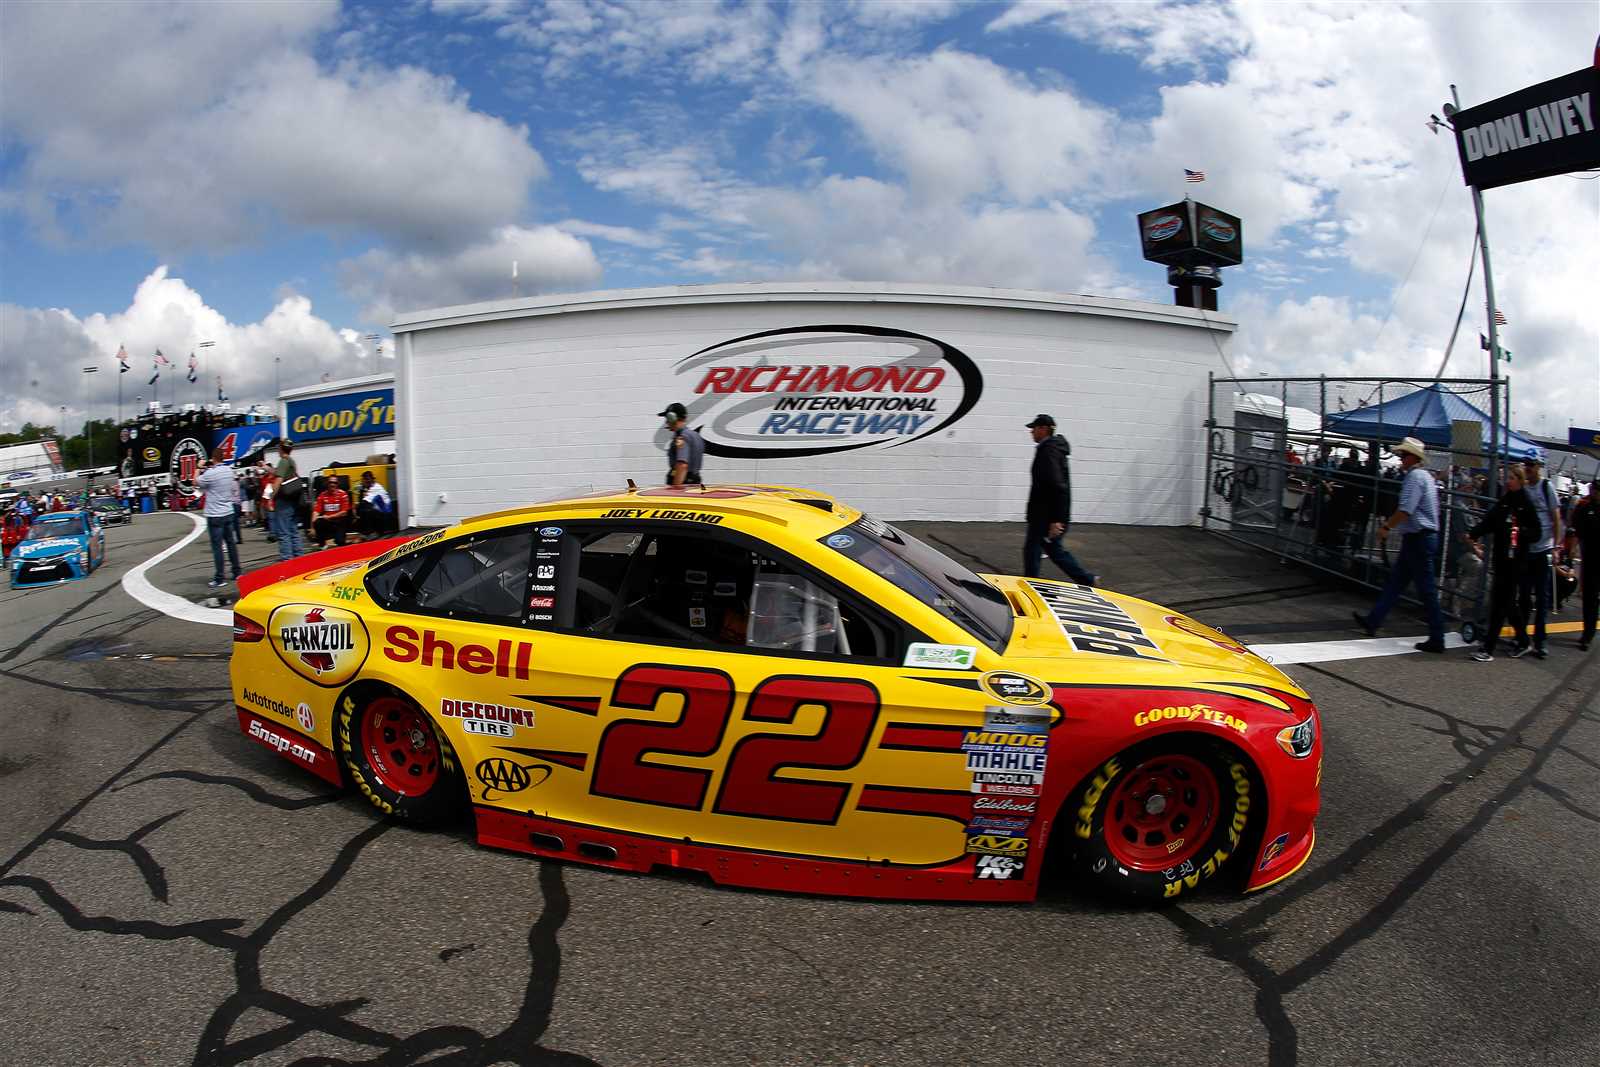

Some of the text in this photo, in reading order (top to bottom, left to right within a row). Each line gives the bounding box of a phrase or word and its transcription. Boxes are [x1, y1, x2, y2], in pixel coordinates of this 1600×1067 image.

[1462, 92, 1594, 162] DONLAVEY
[695, 366, 945, 394] RICHMOND
[773, 397, 937, 411] INTERNATIONAL
[758, 413, 934, 435] RACEWAY
[216, 433, 237, 461] 4
[600, 509, 724, 525] JOEY LOGANO
[331, 586, 364, 600] SKF
[281, 624, 354, 651] PENNZOIL
[384, 625, 533, 681] Shell
[243, 687, 295, 719] Autotrader
[441, 699, 534, 728] DISCOUNT
[467, 720, 513, 736] TIRE
[1134, 704, 1248, 733] GOODYEAR
[589, 662, 882, 826] 22
[963, 731, 1048, 747] MOOG
[968, 752, 1045, 770] MAHLE
[483, 759, 525, 791] AAA
[975, 773, 1031, 784] LINCOLN
[986, 785, 1034, 794] WELDERS
[973, 797, 1035, 812] Edelbrock
